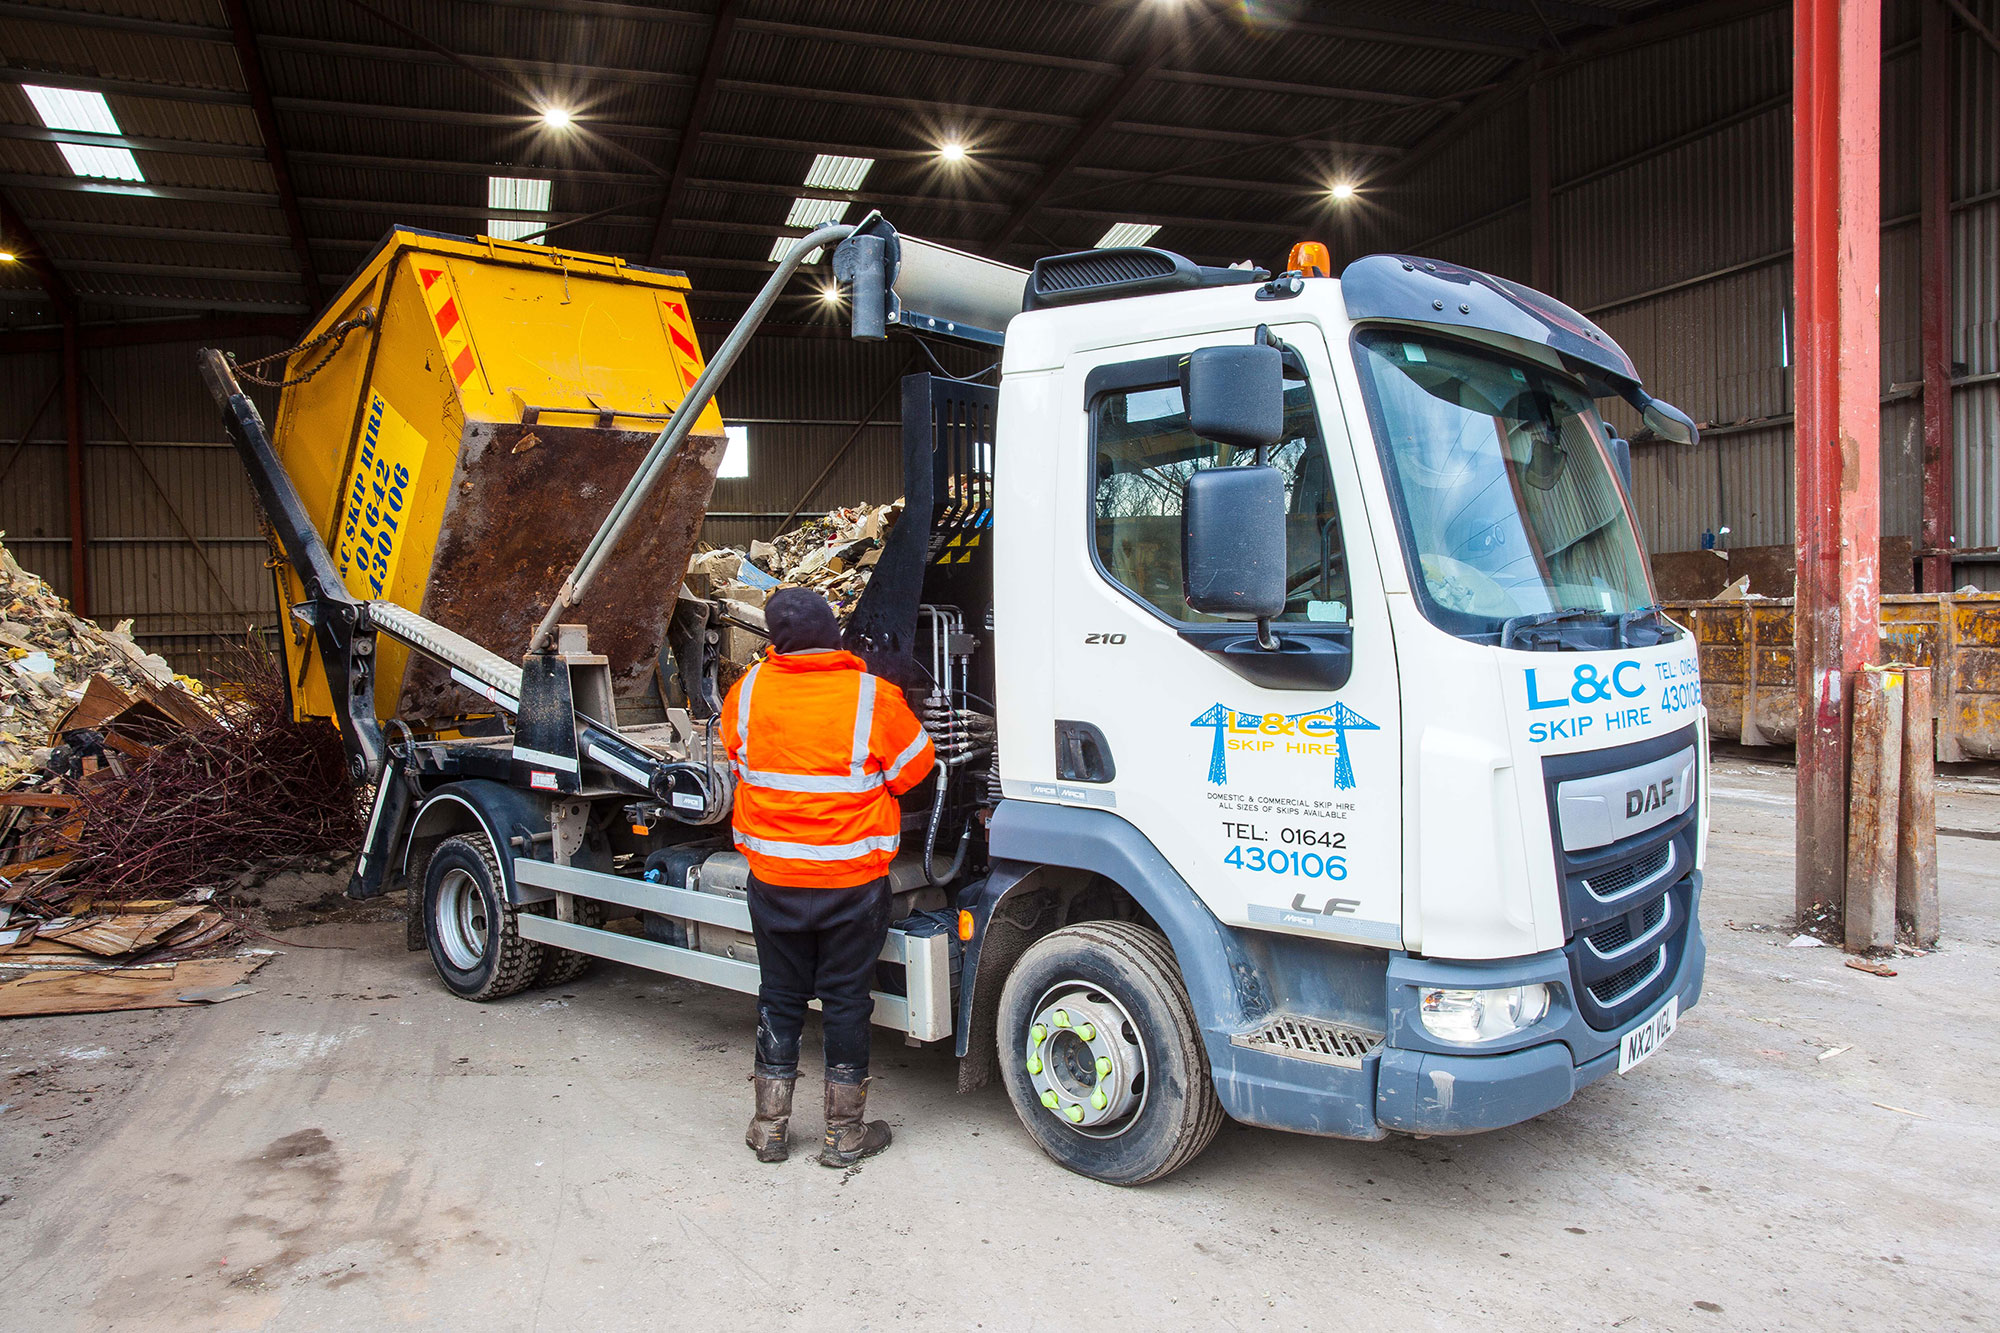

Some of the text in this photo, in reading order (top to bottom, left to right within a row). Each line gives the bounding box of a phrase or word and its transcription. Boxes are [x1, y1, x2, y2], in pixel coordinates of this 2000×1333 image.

[345, 472, 366, 543] SKIP
[360, 394, 385, 471] HIRE
[356, 458, 390, 571] 01642
[369, 462, 409, 600] 430106
[1085, 633, 1127, 645] 210
[1523, 660, 1646, 711] L&C
[1662, 680, 1701, 713] 430106
[1228, 711, 1336, 738] L&C
[1528, 706, 1651, 743] SKIP HIRE
[1227, 739, 1338, 755] SKIP HIRE
[1207, 792, 1245, 802] DOMESTIC
[1257, 796, 1310, 807] COMMERCIAL
[1313, 800, 1332, 809] SKIP
[1335, 802, 1356, 811] HIRE
[1219, 802, 1347, 819] ALL SIZES OF SKIPS AVAILABLE
[1625, 777, 1674, 819] DAF
[1222, 822, 1347, 849] TEL: 01642
[1223, 845, 1348, 881] 430106
[1291, 893, 1361, 916] LF
[1628, 1021, 1655, 1064] NX21
